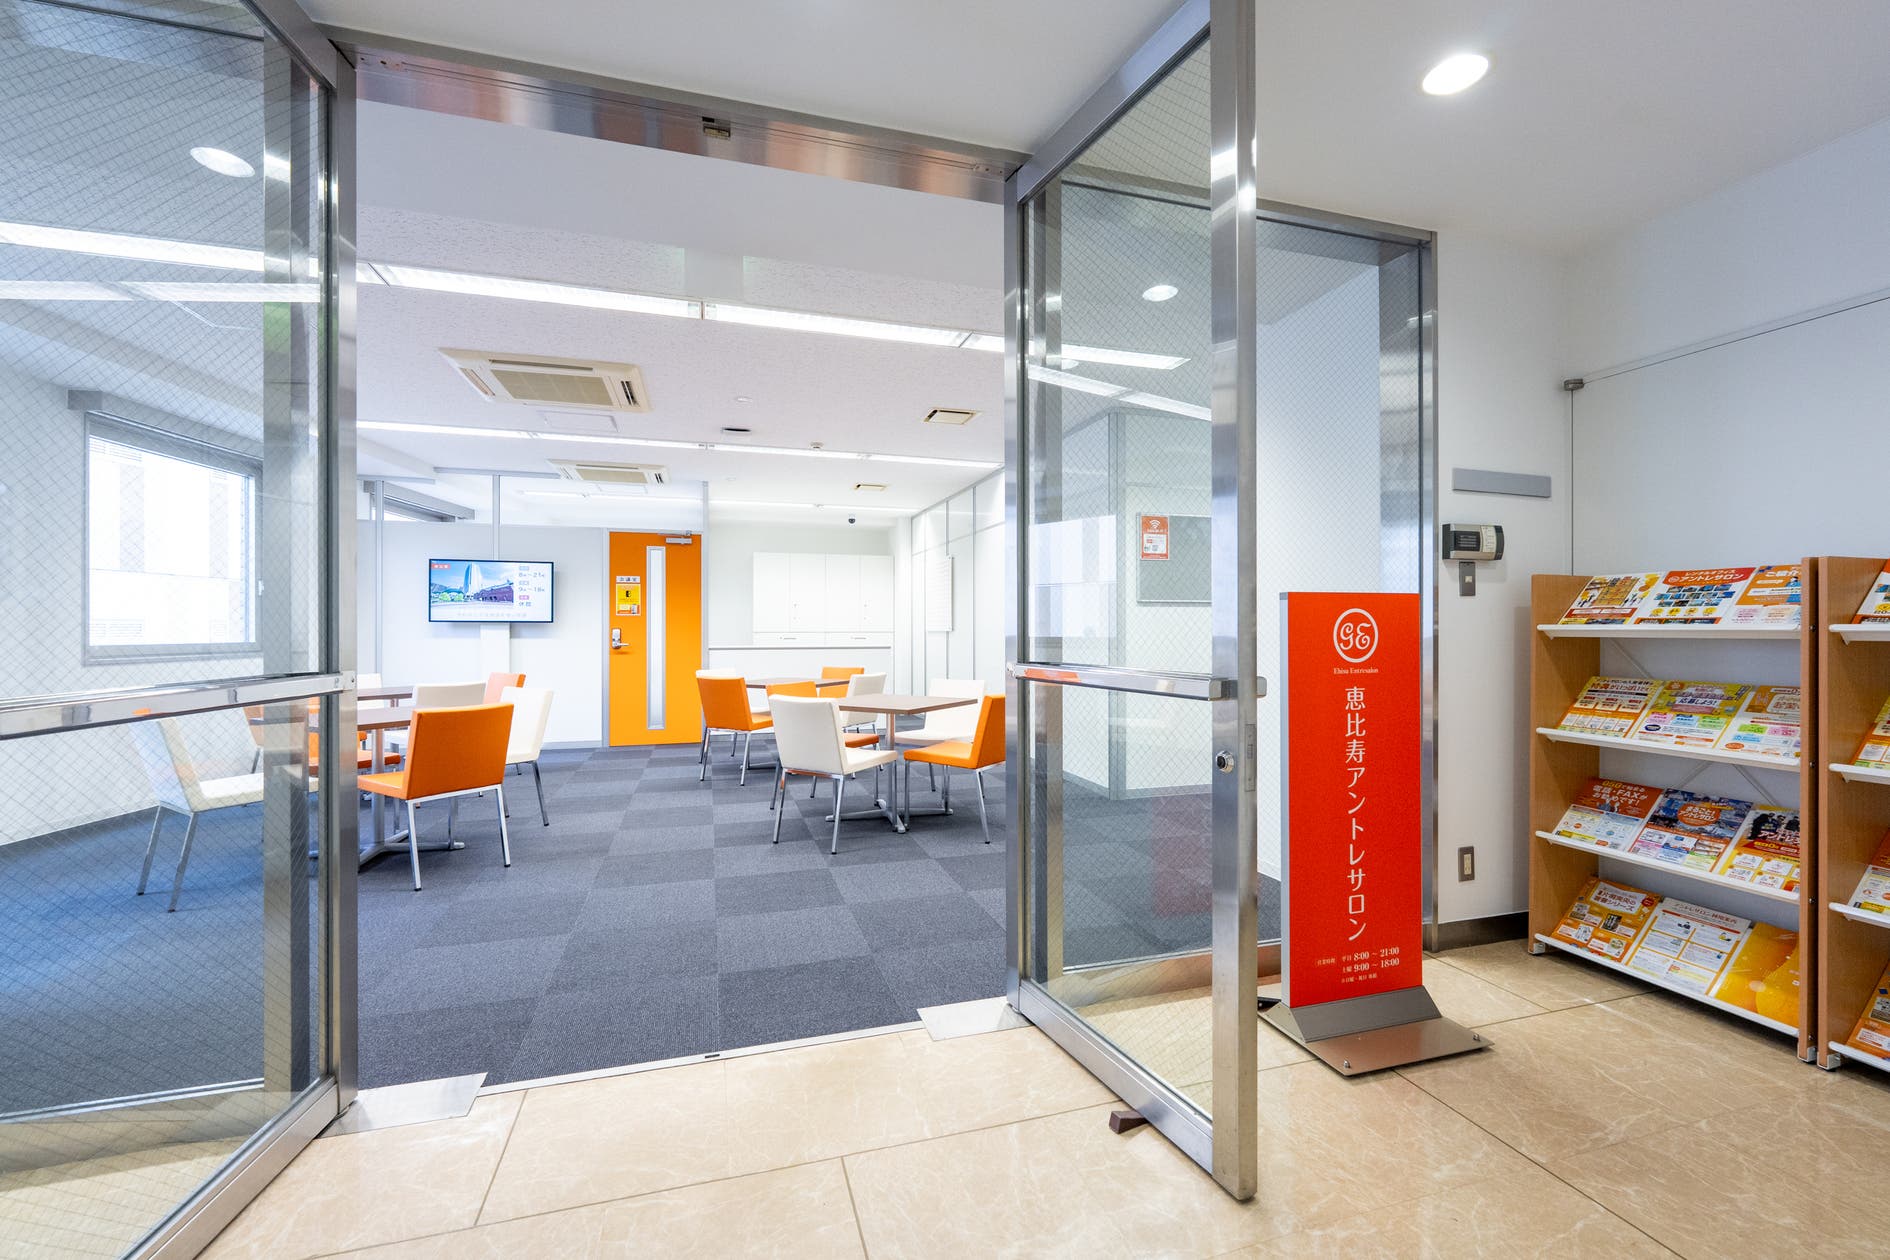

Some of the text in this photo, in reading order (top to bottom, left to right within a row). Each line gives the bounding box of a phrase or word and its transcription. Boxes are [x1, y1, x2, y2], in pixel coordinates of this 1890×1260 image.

[1679, 573, 1744, 582] アントレサロン
[1333, 666, 1379, 675] Ebisu Entresalon
[1345, 685, 1367, 941] 恵比寿アントレサロン
[1353, 951, 1370, 961] 8:00
[1380, 946, 1399, 958] 21:00
[1353, 962, 1370, 972] 9:00
[1381, 957, 1400, 969] 18:00
